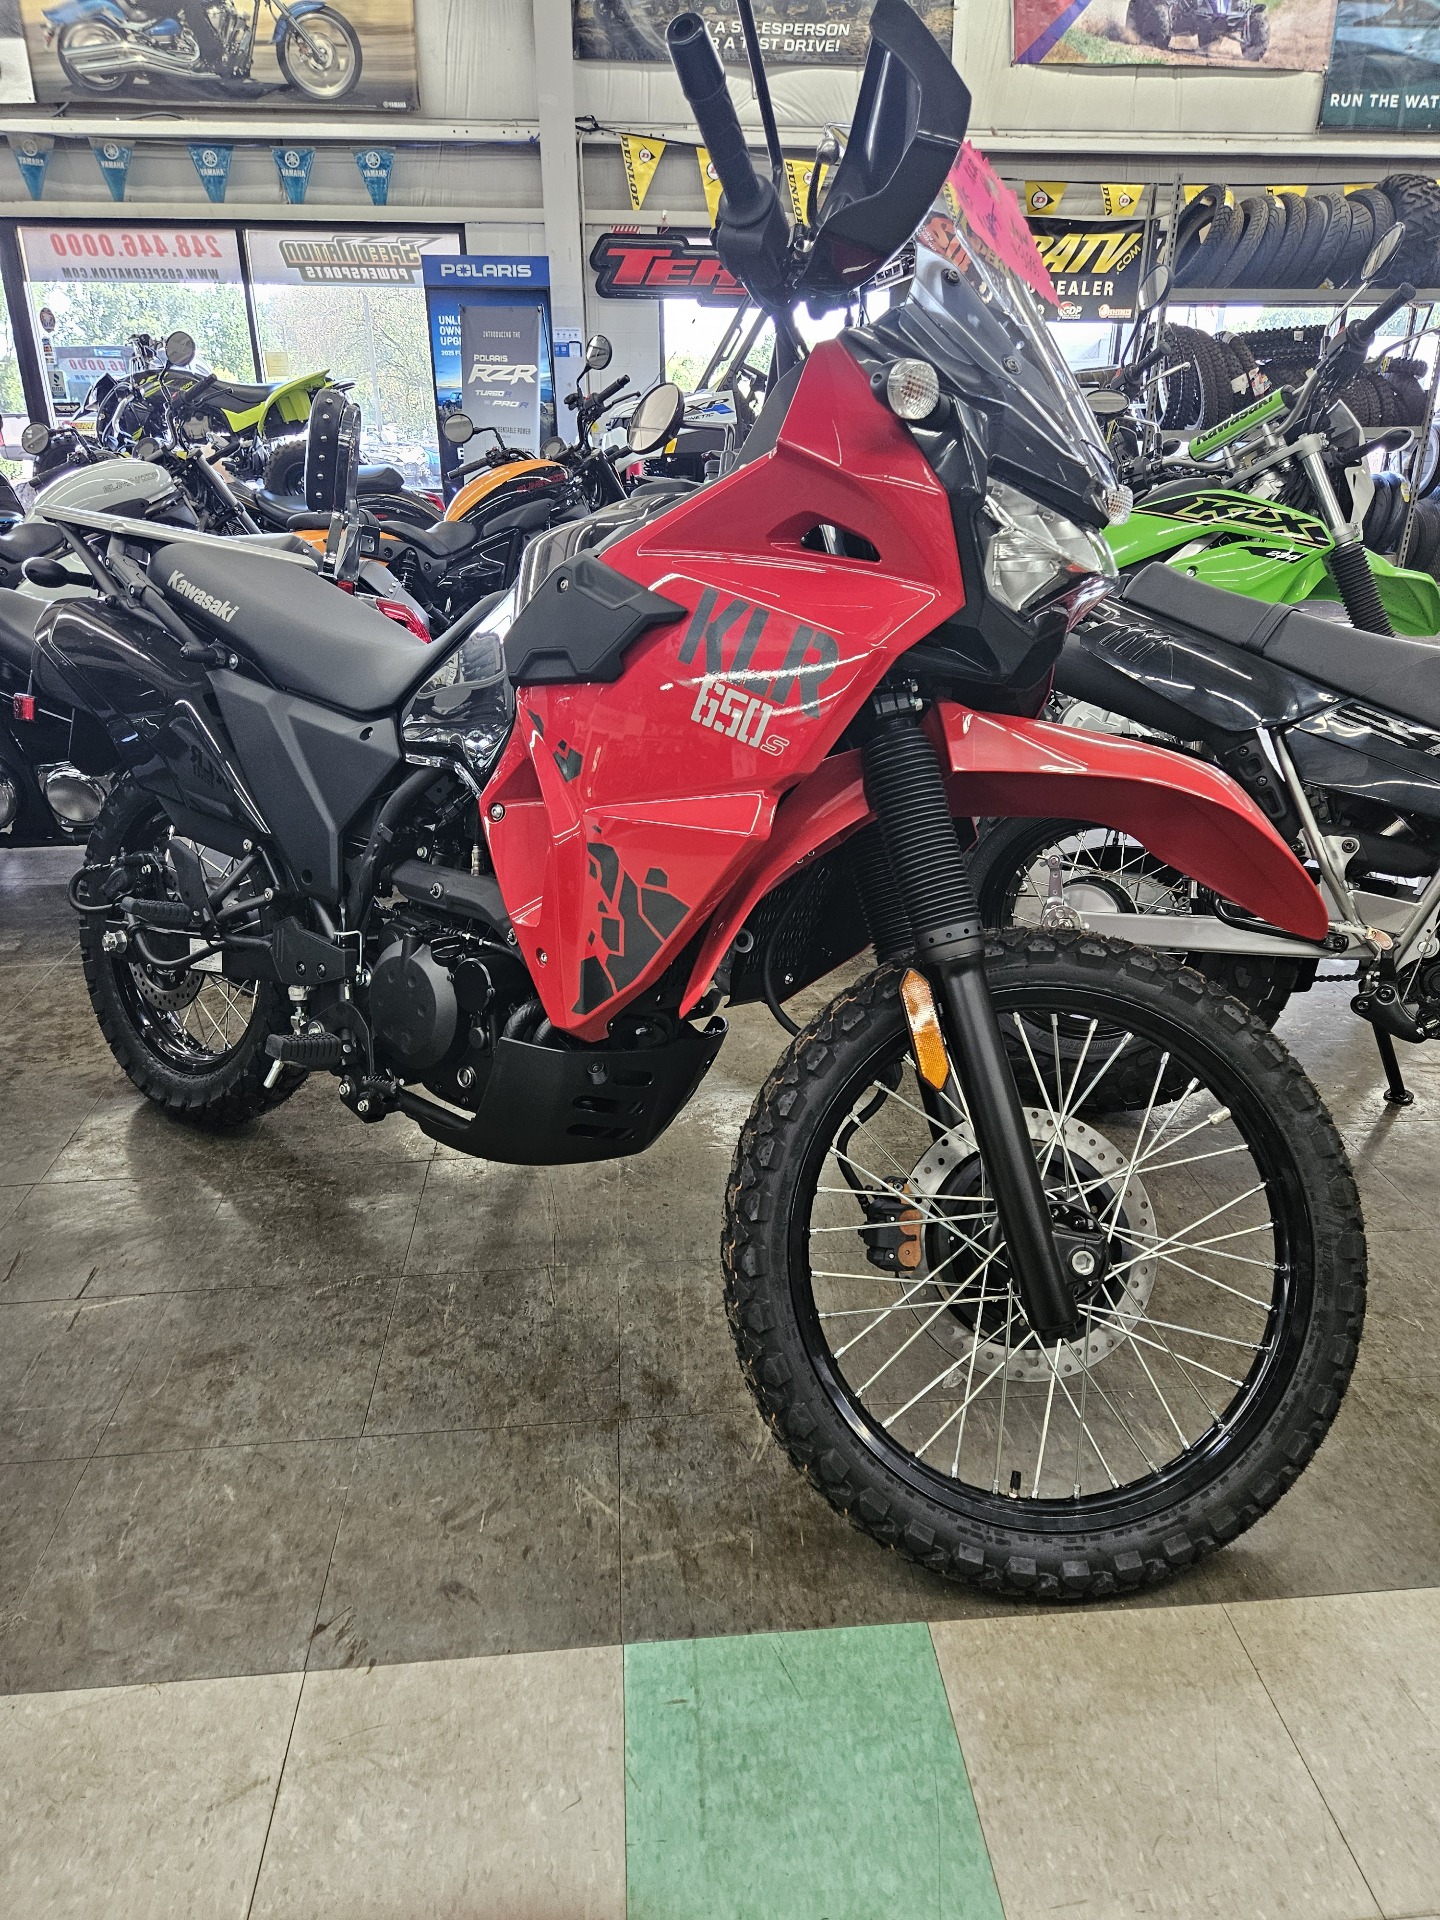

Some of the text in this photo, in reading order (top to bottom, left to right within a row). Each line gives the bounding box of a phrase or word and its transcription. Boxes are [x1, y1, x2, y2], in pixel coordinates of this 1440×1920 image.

[714, 22, 726, 33] A
[731, 22, 850, 36] SLESPERSON
[723, 39, 736, 50] A
[741, 39, 779, 51] TST
[783, 39, 841, 52] DRIVE!
[388, 101, 407, 109] YAMAHA
[1330, 93, 1440, 109] RUN THE WAT
[18, 156, 45, 167] YAMAHA
[101, 160, 126, 170] YAMAHA
[200, 168, 225, 177] YAMAHA
[280, 168, 306, 178] YAMAHA
[363, 169, 387, 178] YAMAHA
[620, 135, 640, 206] DUNLOP
[440, 263, 532, 278] POLARIS
[1050, 280, 1115, 296] EALER
[438, 315, 461, 325] UNL
[512, 331, 521, 339] THE
[440, 337, 461, 346] UPG
[473, 354, 508, 363] POLARIS
[468, 364, 538, 386] RZR
[1174, 497, 1316, 542] KLX
[166, 570, 240, 623] Kawasaki
[677, 585, 840, 720] KLR
